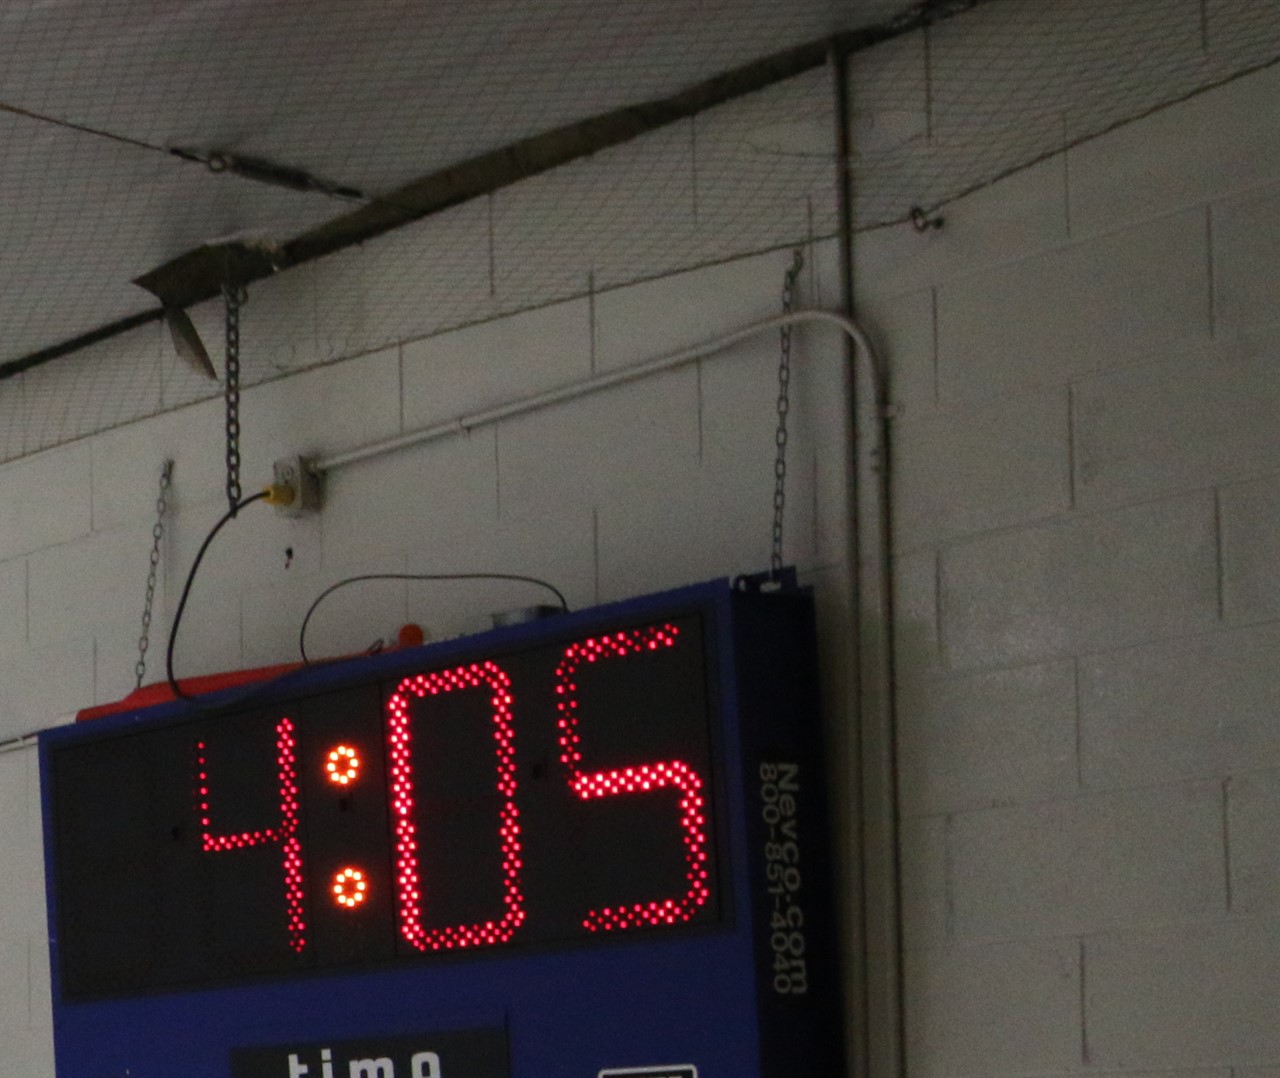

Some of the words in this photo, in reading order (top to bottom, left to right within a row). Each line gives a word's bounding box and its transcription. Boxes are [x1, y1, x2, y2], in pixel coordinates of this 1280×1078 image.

[196, 623, 709, 954] 4:05
[759, 763, 792, 994] 800-851-4040
[778, 763, 808, 994] Nevco.com
